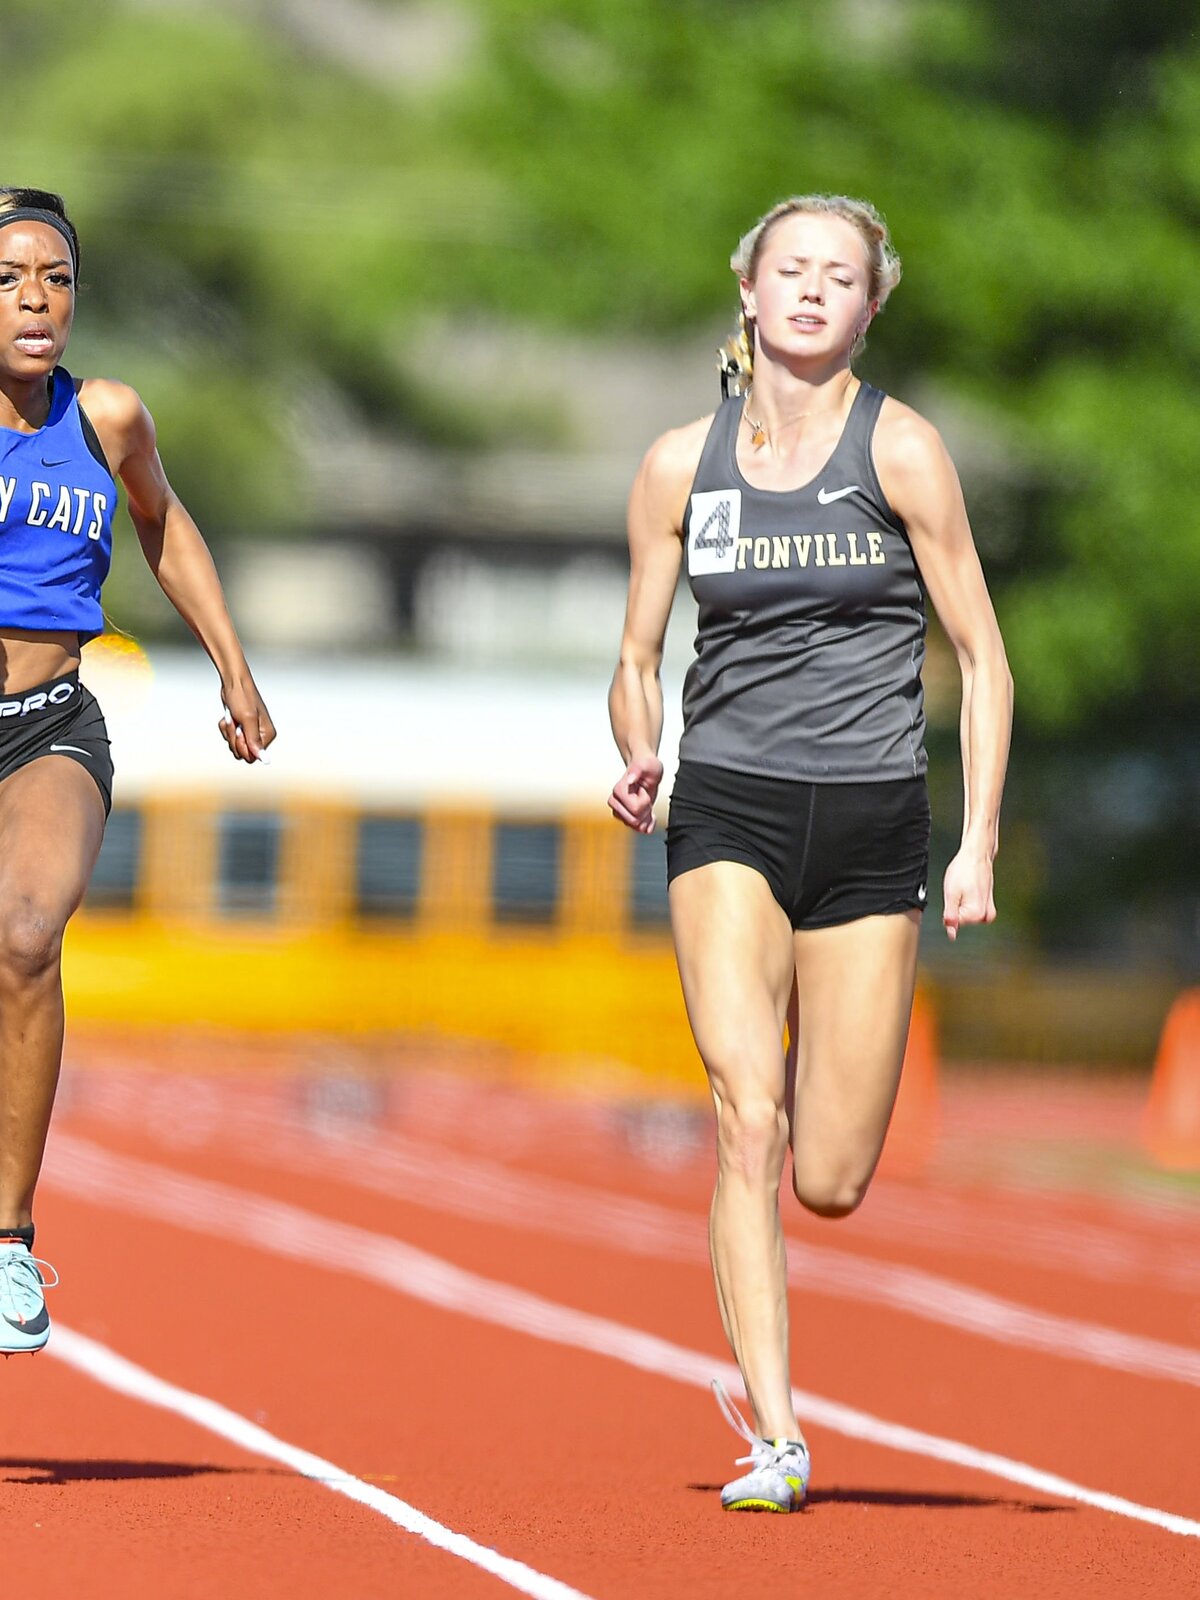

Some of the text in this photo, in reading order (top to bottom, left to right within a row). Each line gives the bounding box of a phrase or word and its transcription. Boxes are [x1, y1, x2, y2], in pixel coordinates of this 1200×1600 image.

[26, 481, 108, 541] CATS
[694, 500, 734, 559] 4
[736, 532, 886, 570] TONVILLE
